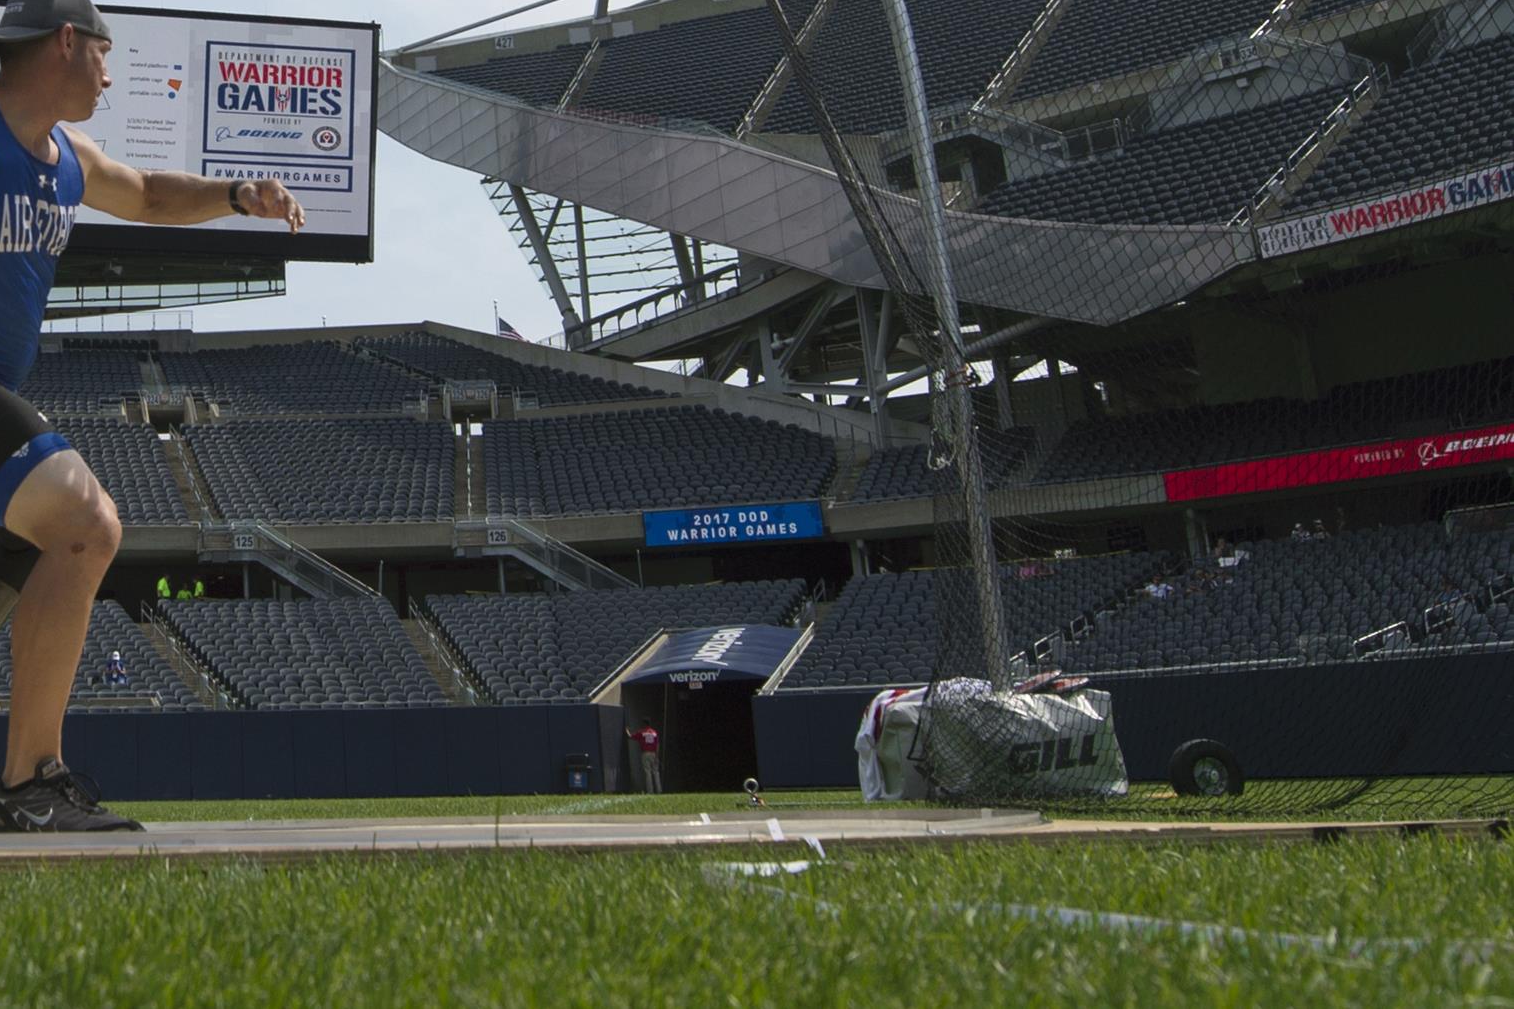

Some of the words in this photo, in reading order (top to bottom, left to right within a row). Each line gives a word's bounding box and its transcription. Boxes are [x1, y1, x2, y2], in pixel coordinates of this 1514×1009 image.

[496, 37, 512, 48] 427
[218, 52, 280, 62] DEPARTMENT
[304, 56, 343, 67] DEFENSE
[219, 62, 342, 88] WARRIOR
[218, 83, 342, 116] GAMES
[263, 117, 292, 125] POWERED
[238, 129, 303, 140] BOEING
[214, 168, 341, 183] #WARRIORGAMES
[1329, 188, 1446, 234] WARRIOR
[1448, 168, 1514, 206] GAM
[1445, 433, 1514, 452] BOEIN
[694, 513, 730, 526] 2017
[739, 511, 768, 522] DOD
[490, 531, 506, 542] 126
[667, 526, 737, 541] WARRIOR
[746, 522, 798, 536] GAMES
[236, 536, 253, 547] 125
[691, 628, 746, 666] verizon
[670, 671, 716, 683] verizon
[1010, 734, 1099, 774] GILL
